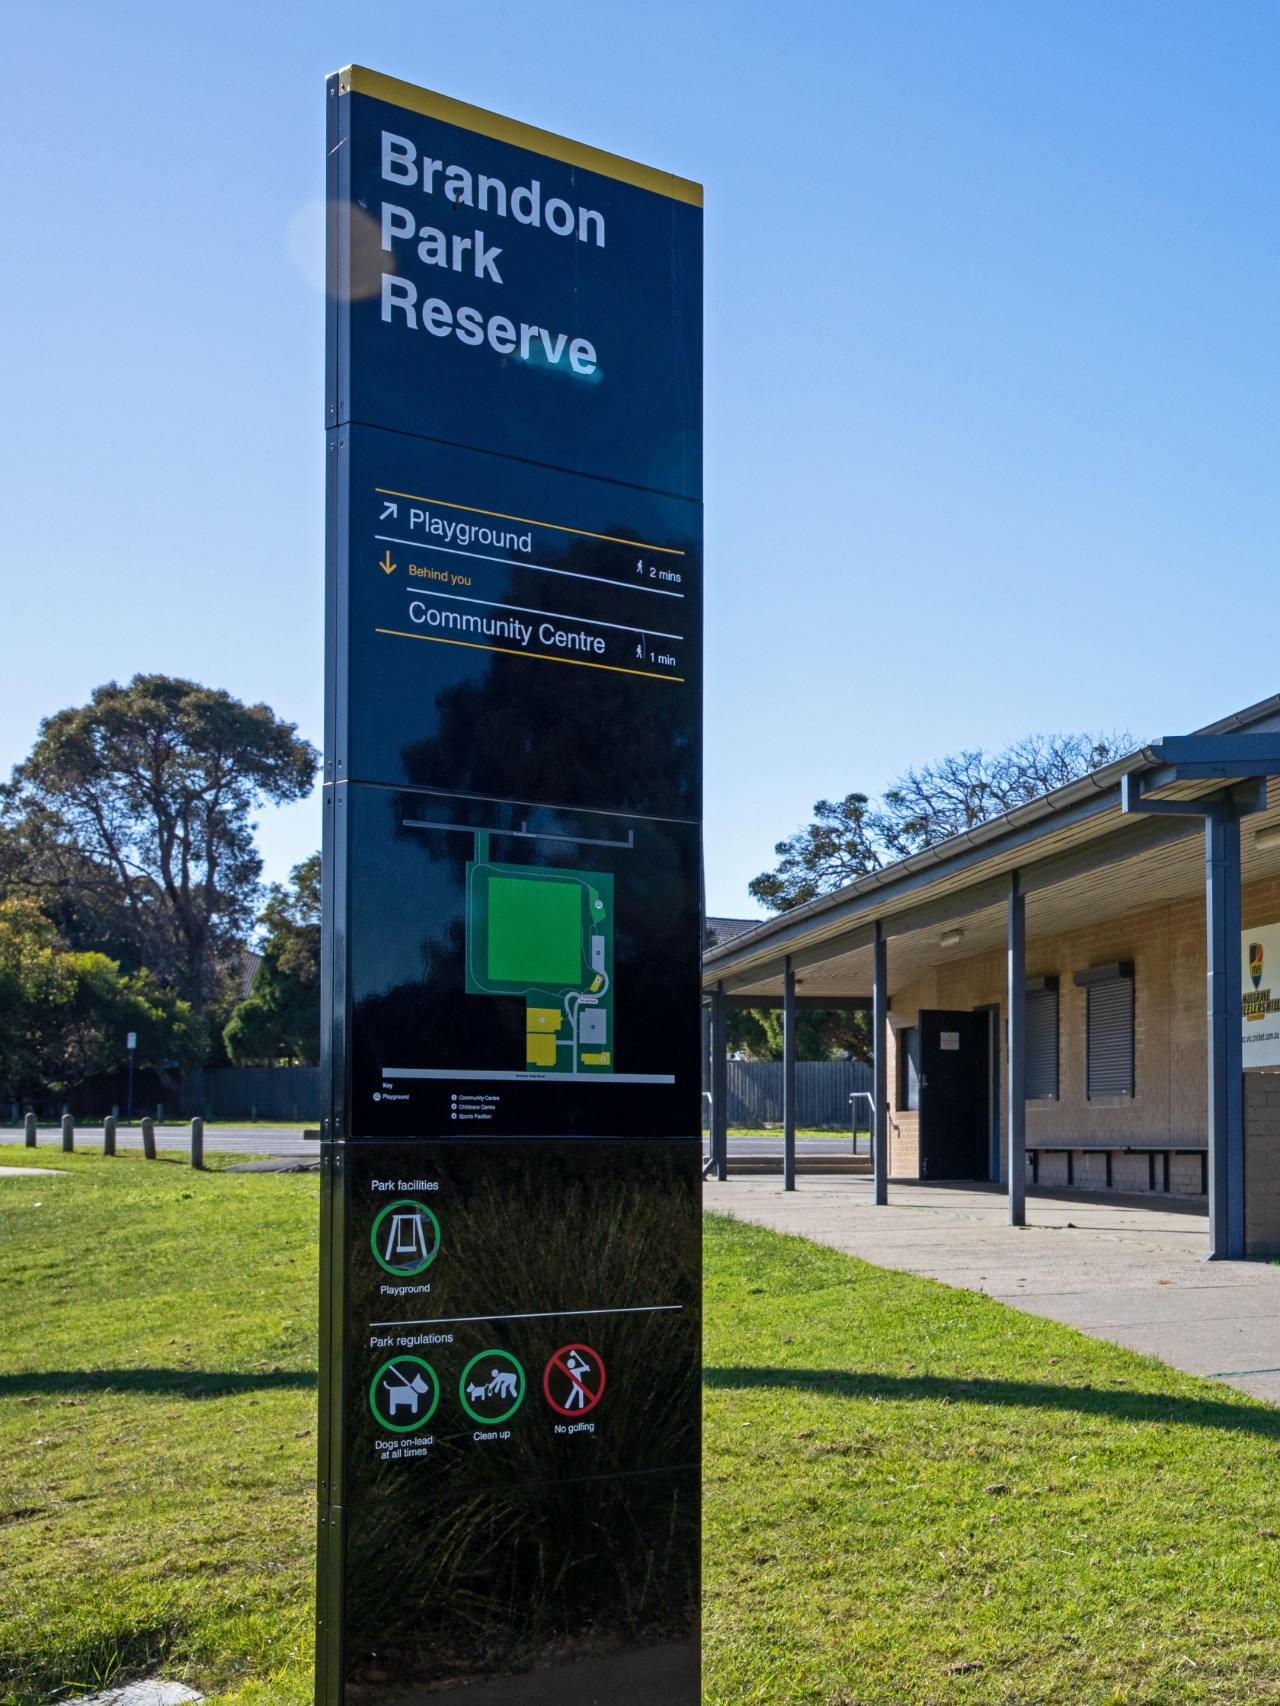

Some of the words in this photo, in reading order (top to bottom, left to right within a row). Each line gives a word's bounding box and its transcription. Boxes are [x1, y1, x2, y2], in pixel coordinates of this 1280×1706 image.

[381, 130, 605, 248] Brandon
[381, 201, 504, 284] Park
[381, 272, 597, 375] Reserve
[409, 508, 532, 553] Playground
[408, 564, 448, 583] Behind
[451, 573, 472, 587] you
[649, 567, 656, 578] 2
[659, 569, 682, 583] mins
[408, 601, 533, 645] Community
[538, 623, 606, 654] Centre
[650, 652, 655, 662] 1
[658, 654, 676, 666] min
[382, 1093, 410, 1101] Playground
[371, 1180, 394, 1191] Park
[398, 1179, 439, 1191] facilities
[380, 1284, 430, 1296] Playground
[370, 1336, 394, 1348] Park
[397, 1332, 454, 1348] regulations
[473, 1430, 498, 1441] Clean
[499, 1432, 511, 1441] up
[554, 1423, 567, 1433] No
[568, 1422, 595, 1435] golfing
[375, 1439, 399, 1452] Dogs
[401, 1436, 433, 1448] on-lead
[381, 1450, 391, 1460] at
[392, 1449, 402, 1459] all
[403, 1447, 427, 1458] times
